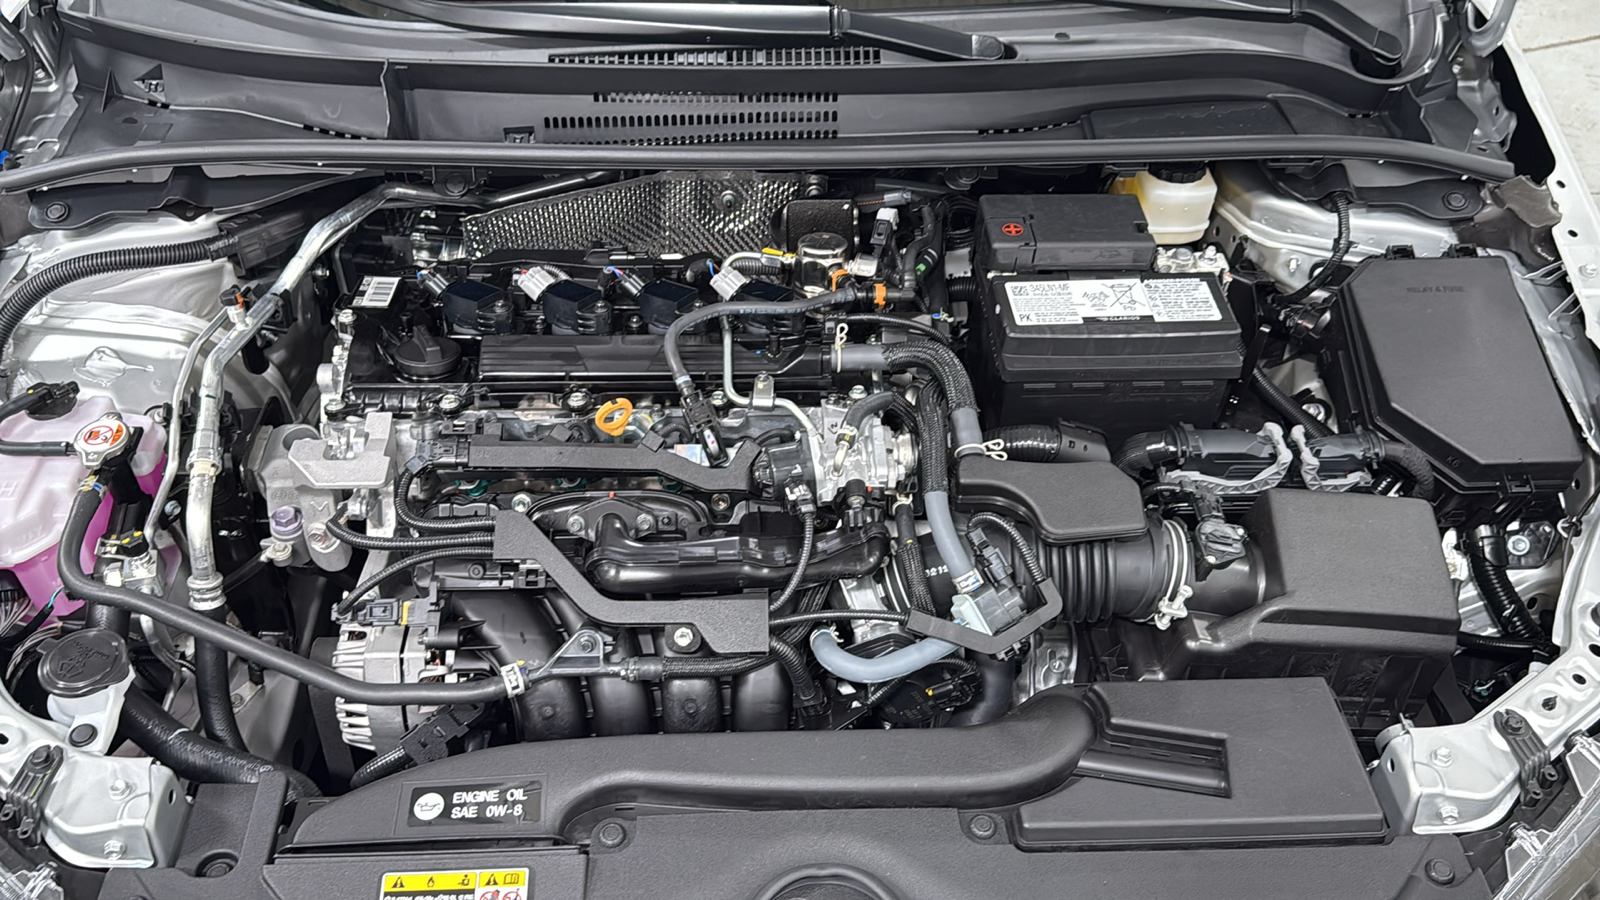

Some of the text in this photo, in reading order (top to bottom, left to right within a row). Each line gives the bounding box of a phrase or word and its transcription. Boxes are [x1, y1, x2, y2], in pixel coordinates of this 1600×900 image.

[1019, 313, 1033, 323] PK
[452, 788, 528, 804] ENGINE OIL
[450, 803, 523, 819] SAE 0W-8
